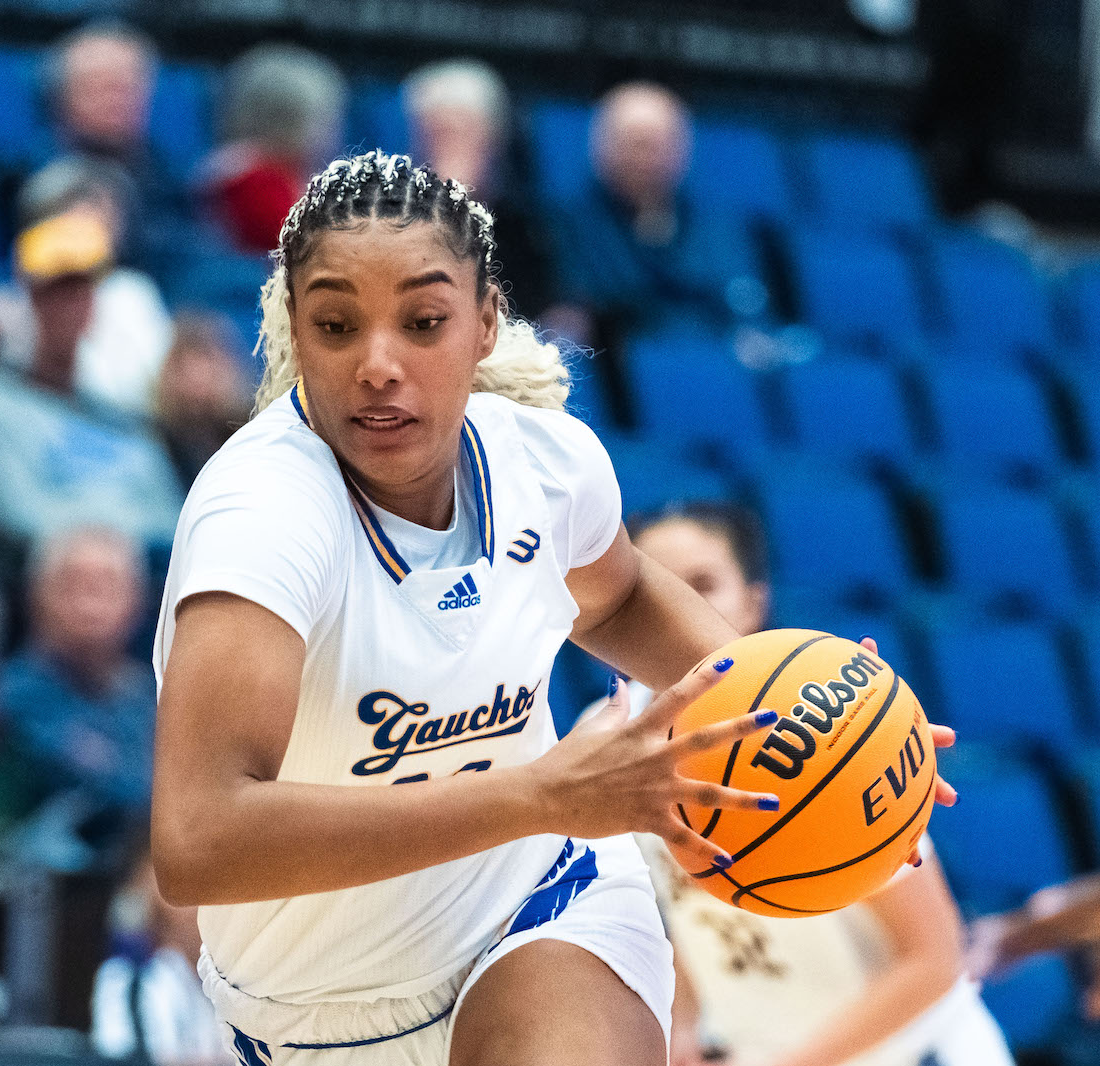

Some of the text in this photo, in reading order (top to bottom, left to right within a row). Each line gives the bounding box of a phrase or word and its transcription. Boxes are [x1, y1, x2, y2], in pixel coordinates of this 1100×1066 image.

[437, 594, 481, 610] adidas
[750, 652, 883, 780] Wilson
[826, 721, 850, 751] INDOOR
